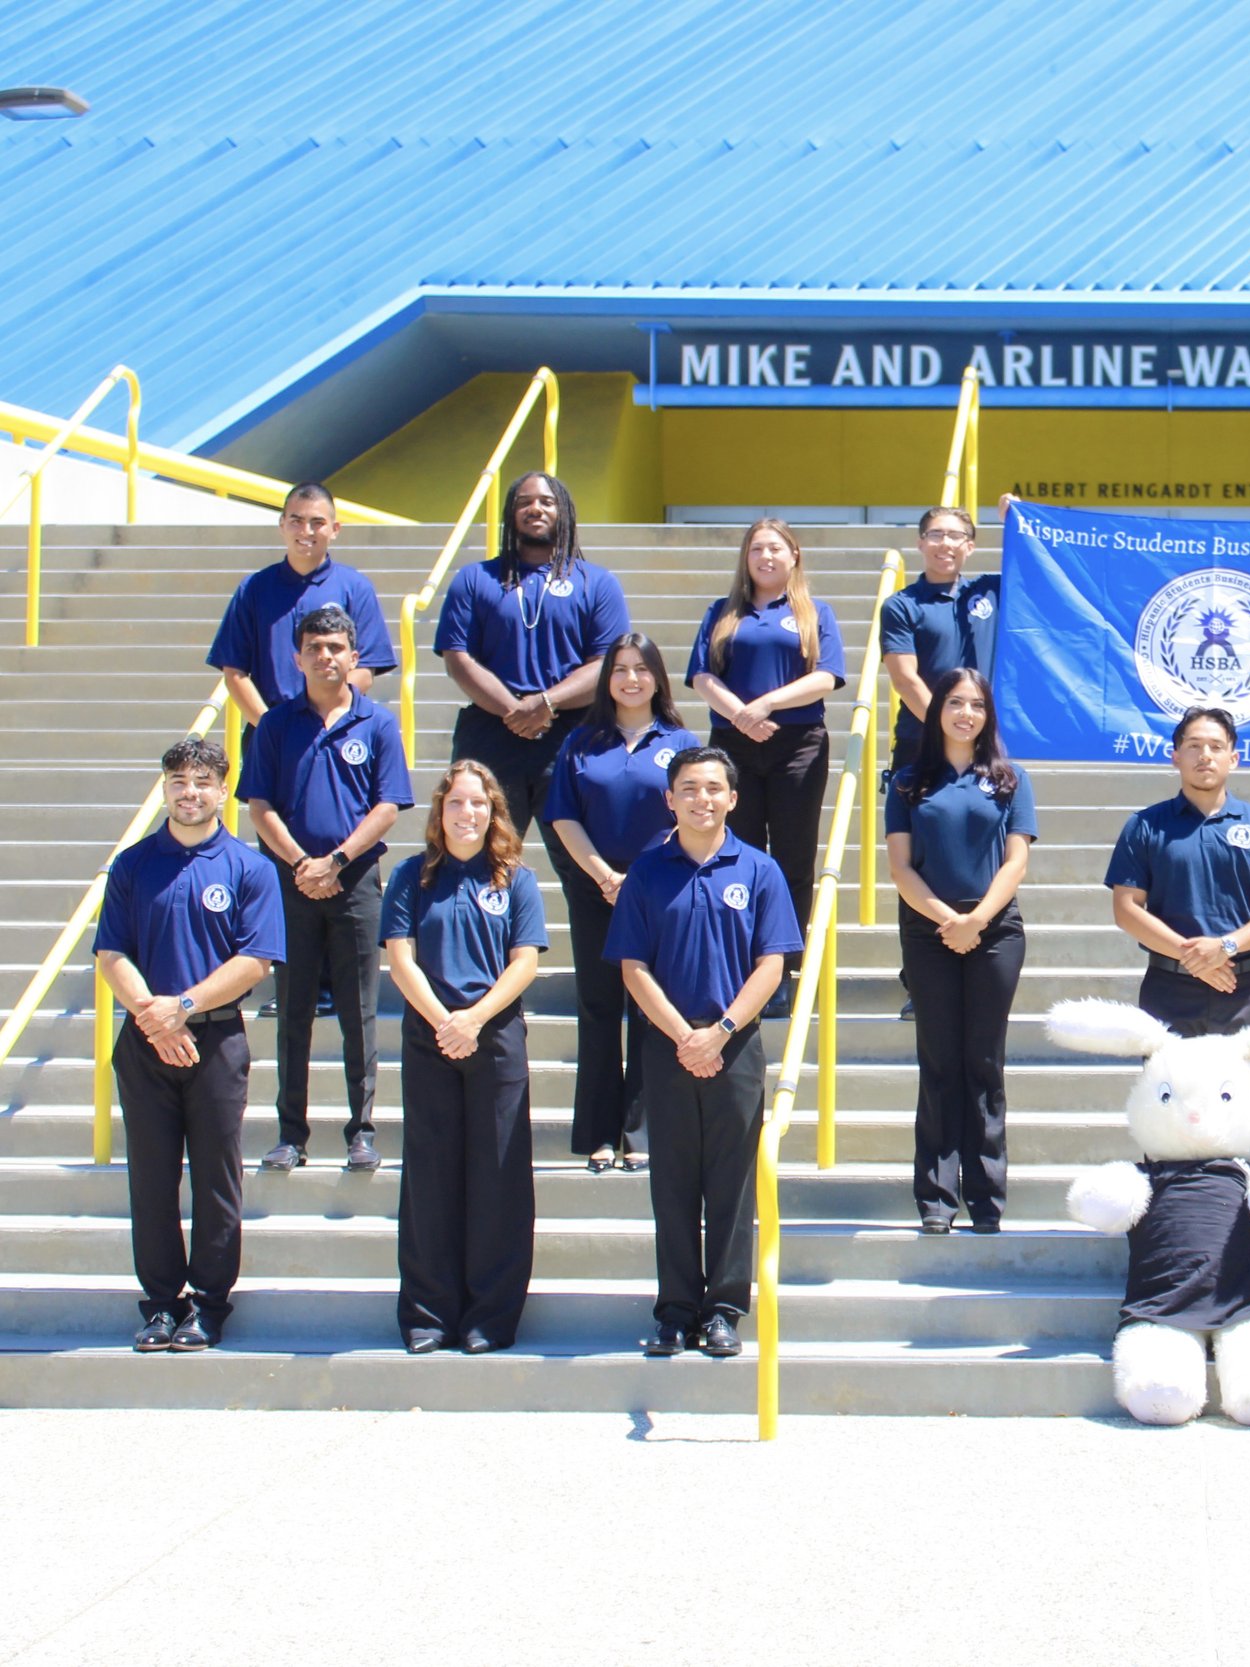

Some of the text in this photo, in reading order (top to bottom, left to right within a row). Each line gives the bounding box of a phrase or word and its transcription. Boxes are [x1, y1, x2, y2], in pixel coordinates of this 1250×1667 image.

[680, 343, 812, 387] MIKE
[830, 343, 943, 387] AND
[967, 343, 1159, 388] ARLINE
[1011, 482, 1088, 499] ALBERT
[1098, 482, 1213, 499] REINGARDT
[1016, 515, 1108, 549] Hispanic
[1112, 531, 1206, 555] Students
[1140, 599, 1166, 642] Hispanic
[1164, 574, 1212, 600] Students
[1190, 656, 1243, 671] HSBA
[1163, 698, 1186, 714] Stat
